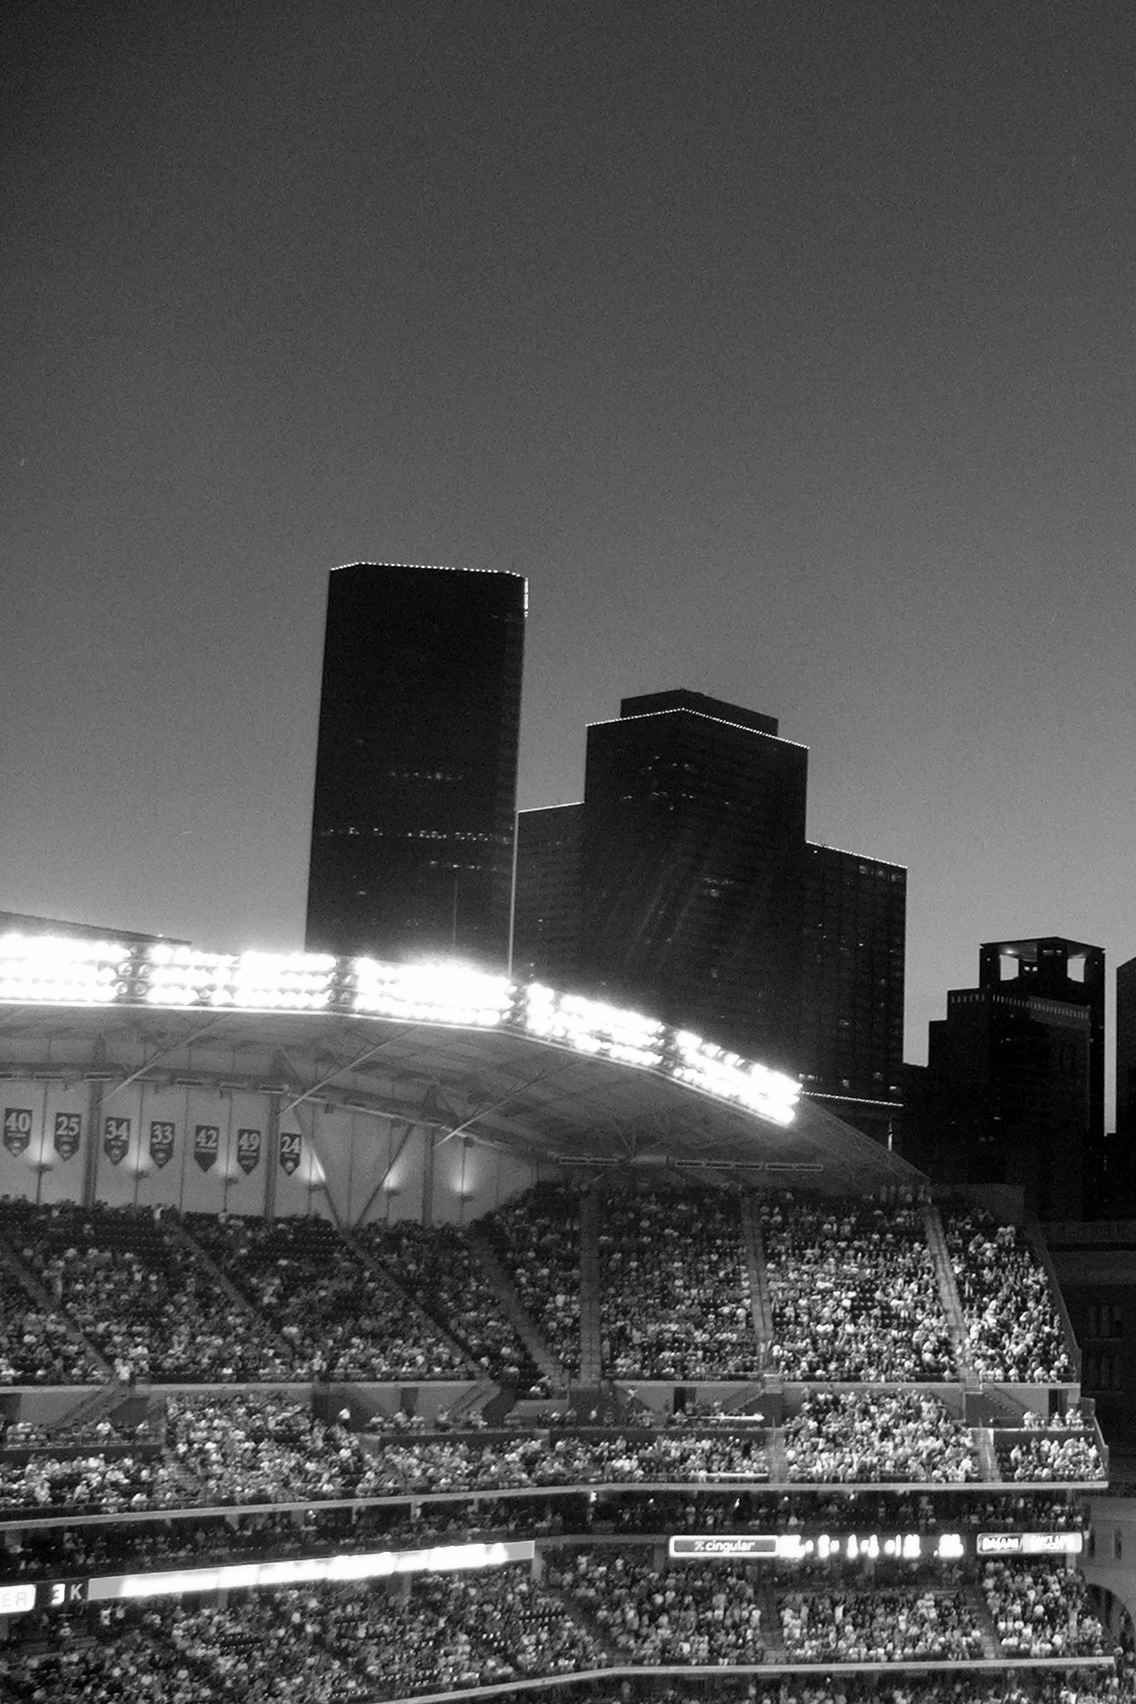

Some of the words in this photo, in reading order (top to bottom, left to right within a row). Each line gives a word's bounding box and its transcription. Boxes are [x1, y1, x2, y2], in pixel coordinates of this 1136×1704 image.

[6, 1111, 30, 1132] 40
[56, 1116, 79, 1135] 25
[105, 1120, 128, 1140] 34
[152, 1124, 172, 1144] 33
[196, 1128, 217, 1148] 42
[240, 1132, 260, 1151] 49
[281, 1135, 300, 1153] 24
[705, 1539, 755, 1552] cingular
[50, 1583, 66, 1605] 3
[70, 1583, 83, 1600] K
